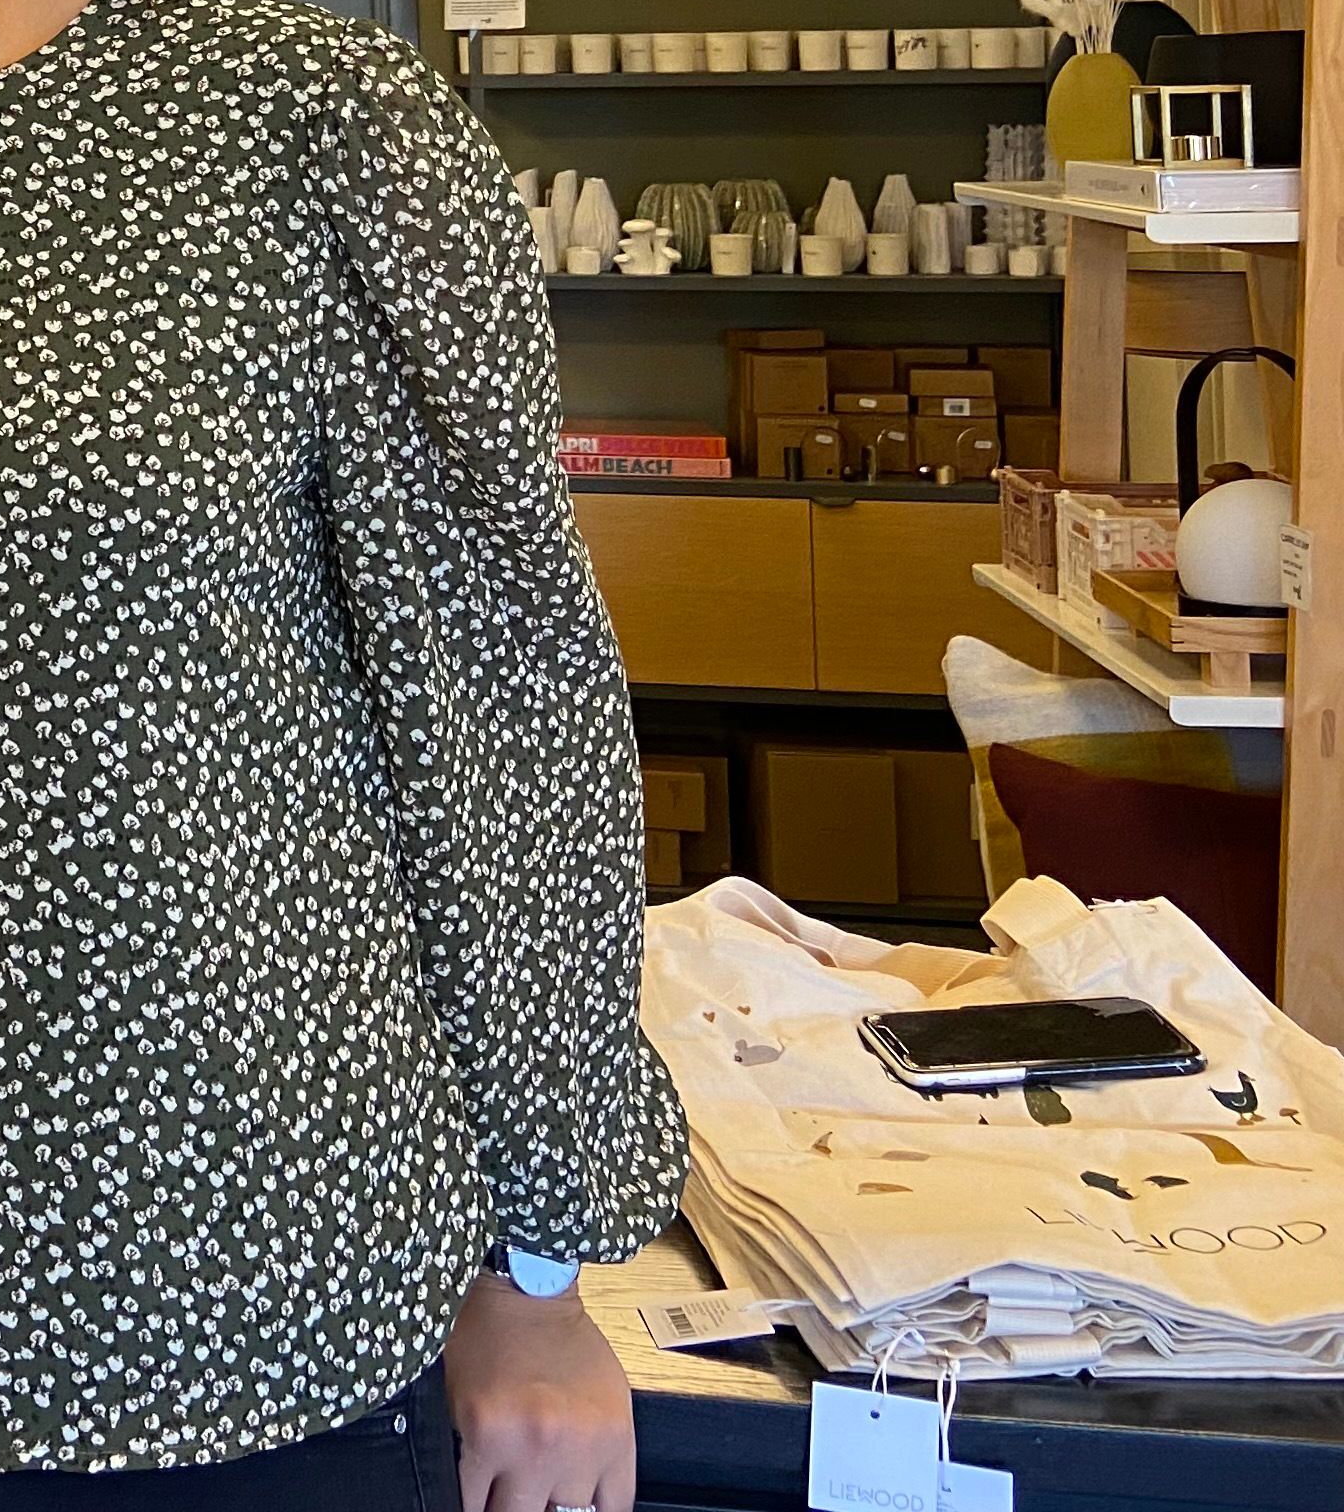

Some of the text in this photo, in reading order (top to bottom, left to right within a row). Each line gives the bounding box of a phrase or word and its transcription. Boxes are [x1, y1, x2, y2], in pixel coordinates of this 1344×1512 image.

[557, 437, 599, 454] APRI
[558, 456, 673, 475] ALM BEACH
[1024, 1205, 1328, 1256] LIWOOD
[828, 1479, 924, 1512] LIEWOOD
